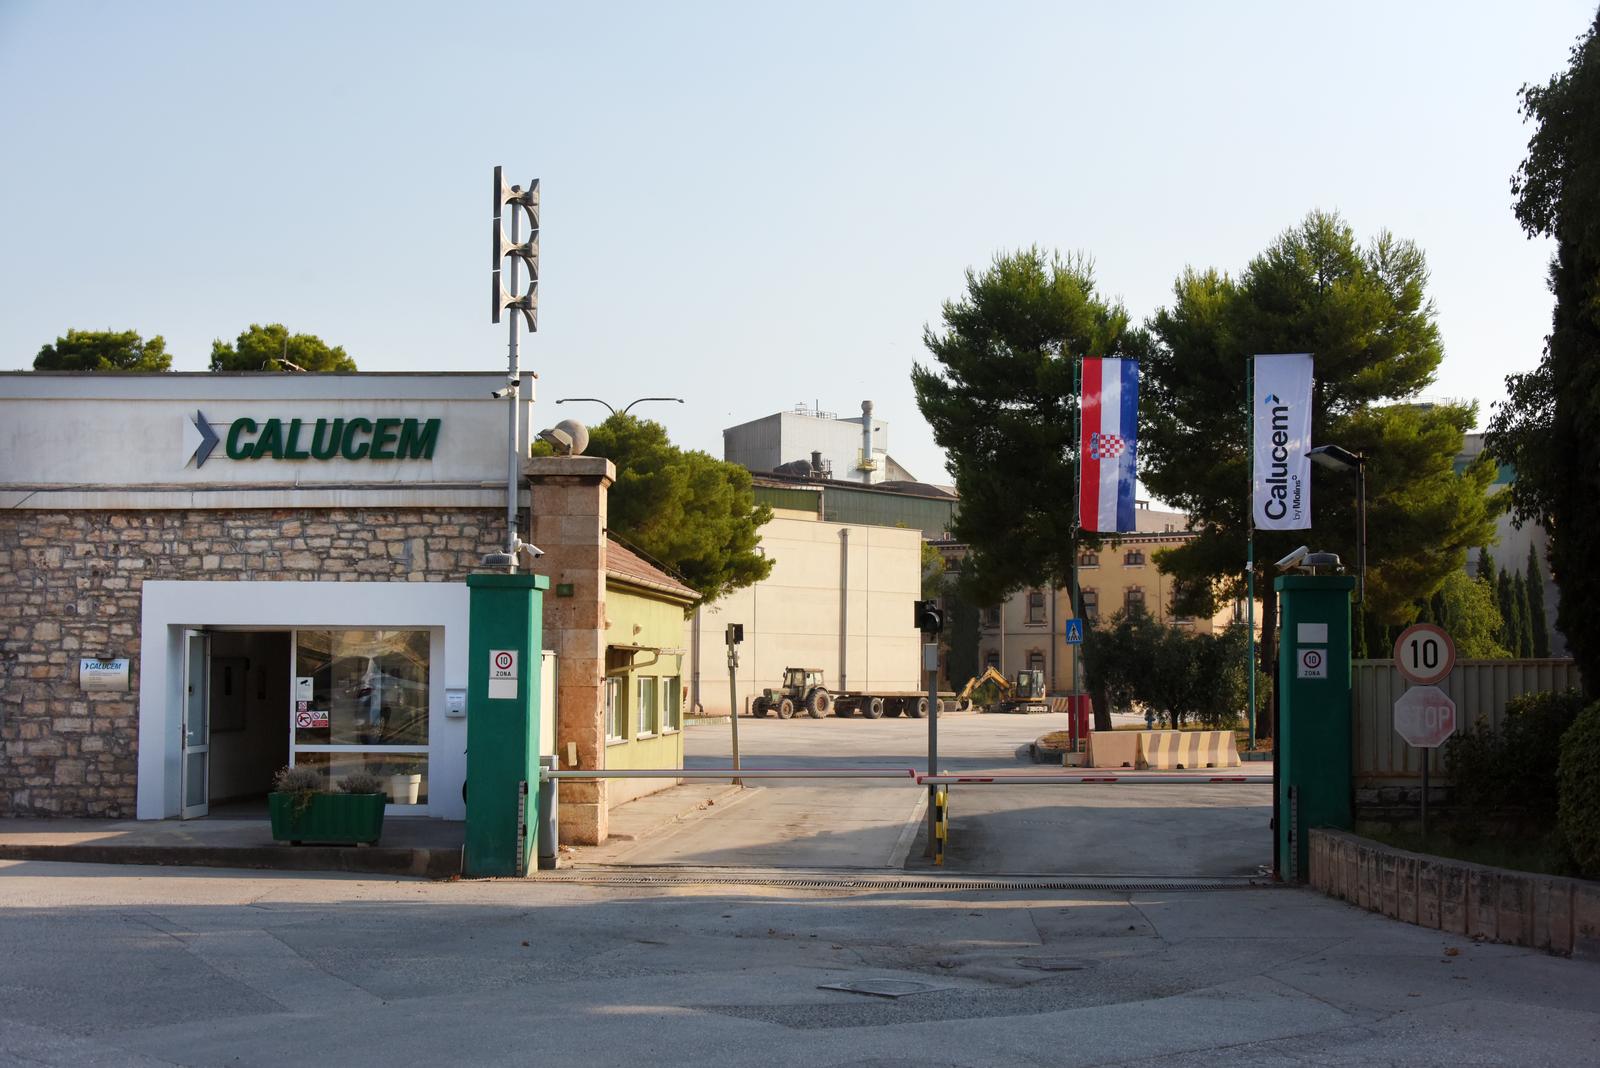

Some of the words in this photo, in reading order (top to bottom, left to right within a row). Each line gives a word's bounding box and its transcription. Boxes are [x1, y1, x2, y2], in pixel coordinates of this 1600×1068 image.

[226, 418, 441, 460] CALUCEM
[1265, 406, 1288, 520] Calucem
[1292, 479, 1301, 509] Molins
[1292, 509, 1302, 520] by
[500, 656, 508, 665] 10
[1308, 655, 1317, 664] 10
[1411, 639, 1438, 669] 10
[90, 662, 122, 670] CALUCEM
